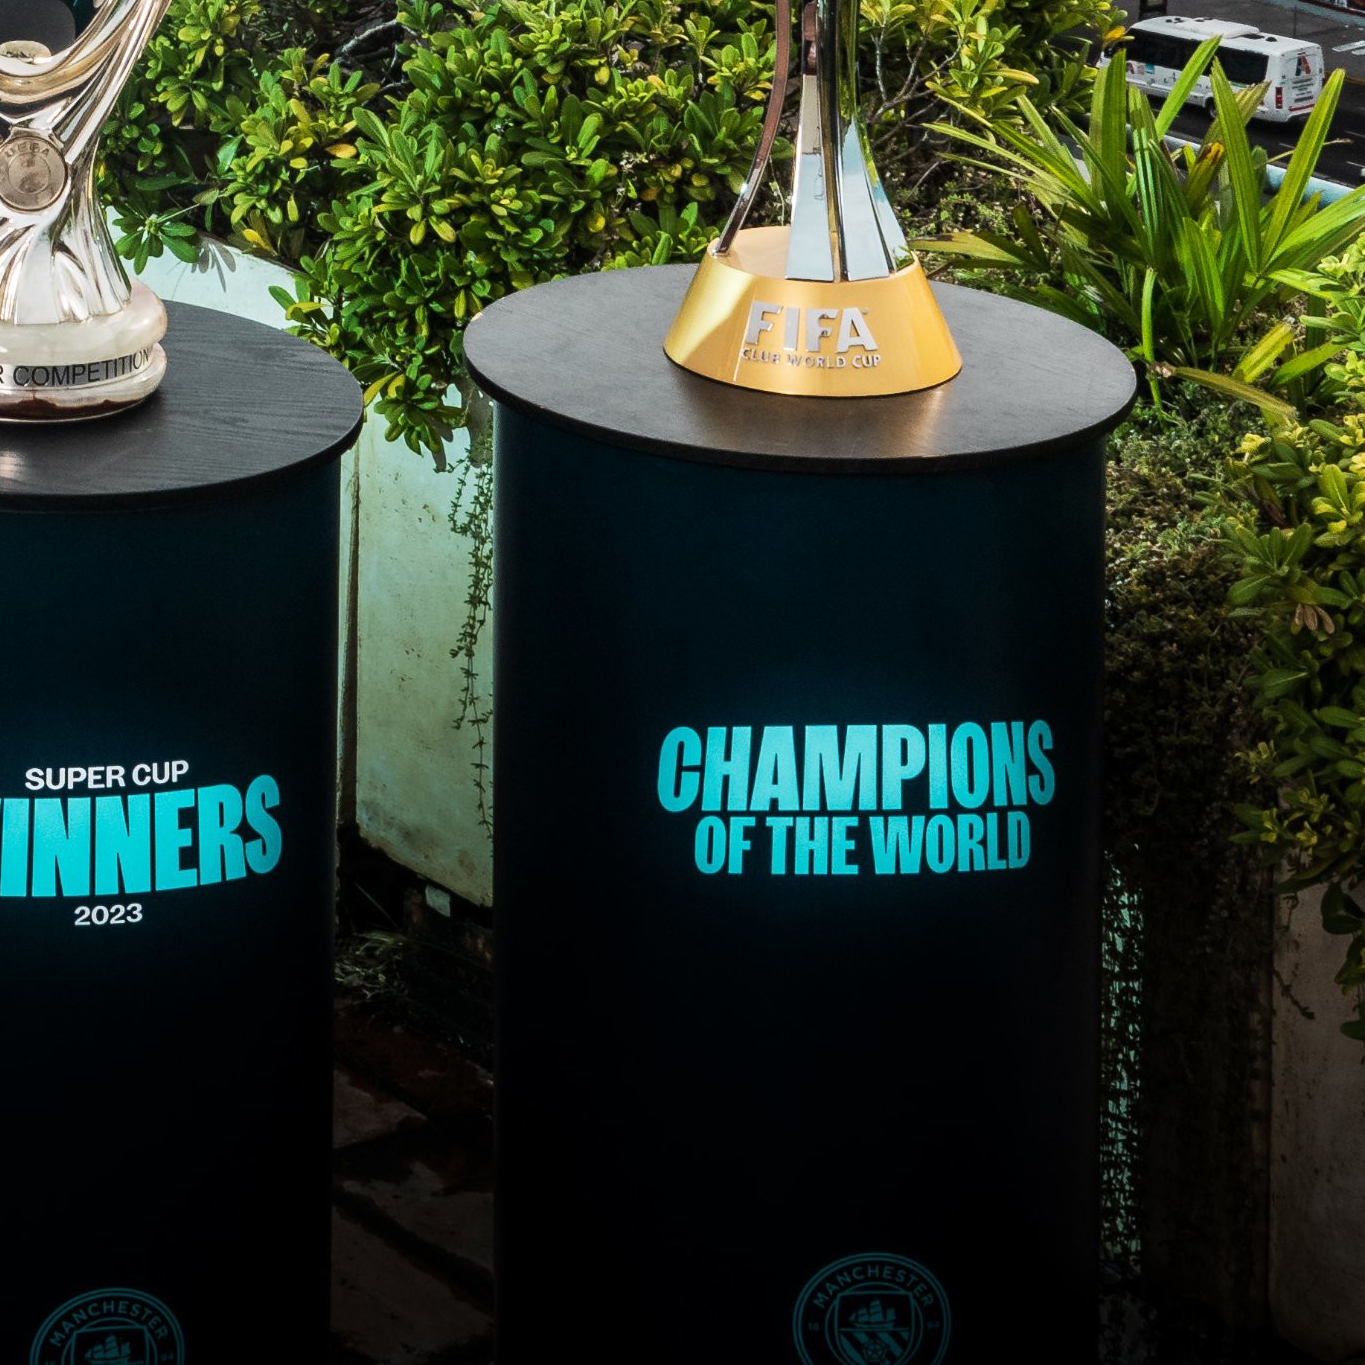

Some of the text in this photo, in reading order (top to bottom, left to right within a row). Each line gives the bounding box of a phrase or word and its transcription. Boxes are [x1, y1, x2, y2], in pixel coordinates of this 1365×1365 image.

[745, 300, 879, 354] FIFA
[12, 345, 154, 388] COMPETITION
[742, 347, 882, 370] CLUB WORLD CUP
[24, 759, 190, 791] SUPER CUP
[657, 719, 1057, 814] CHAMPIONS
[694, 811, 1031, 876] OF THE WORLD
[73, 902, 144, 926] 2023
[812, 1264, 934, 1310] MANCHESTER
[48, 1300, 169, 1347] MANCHESTER
